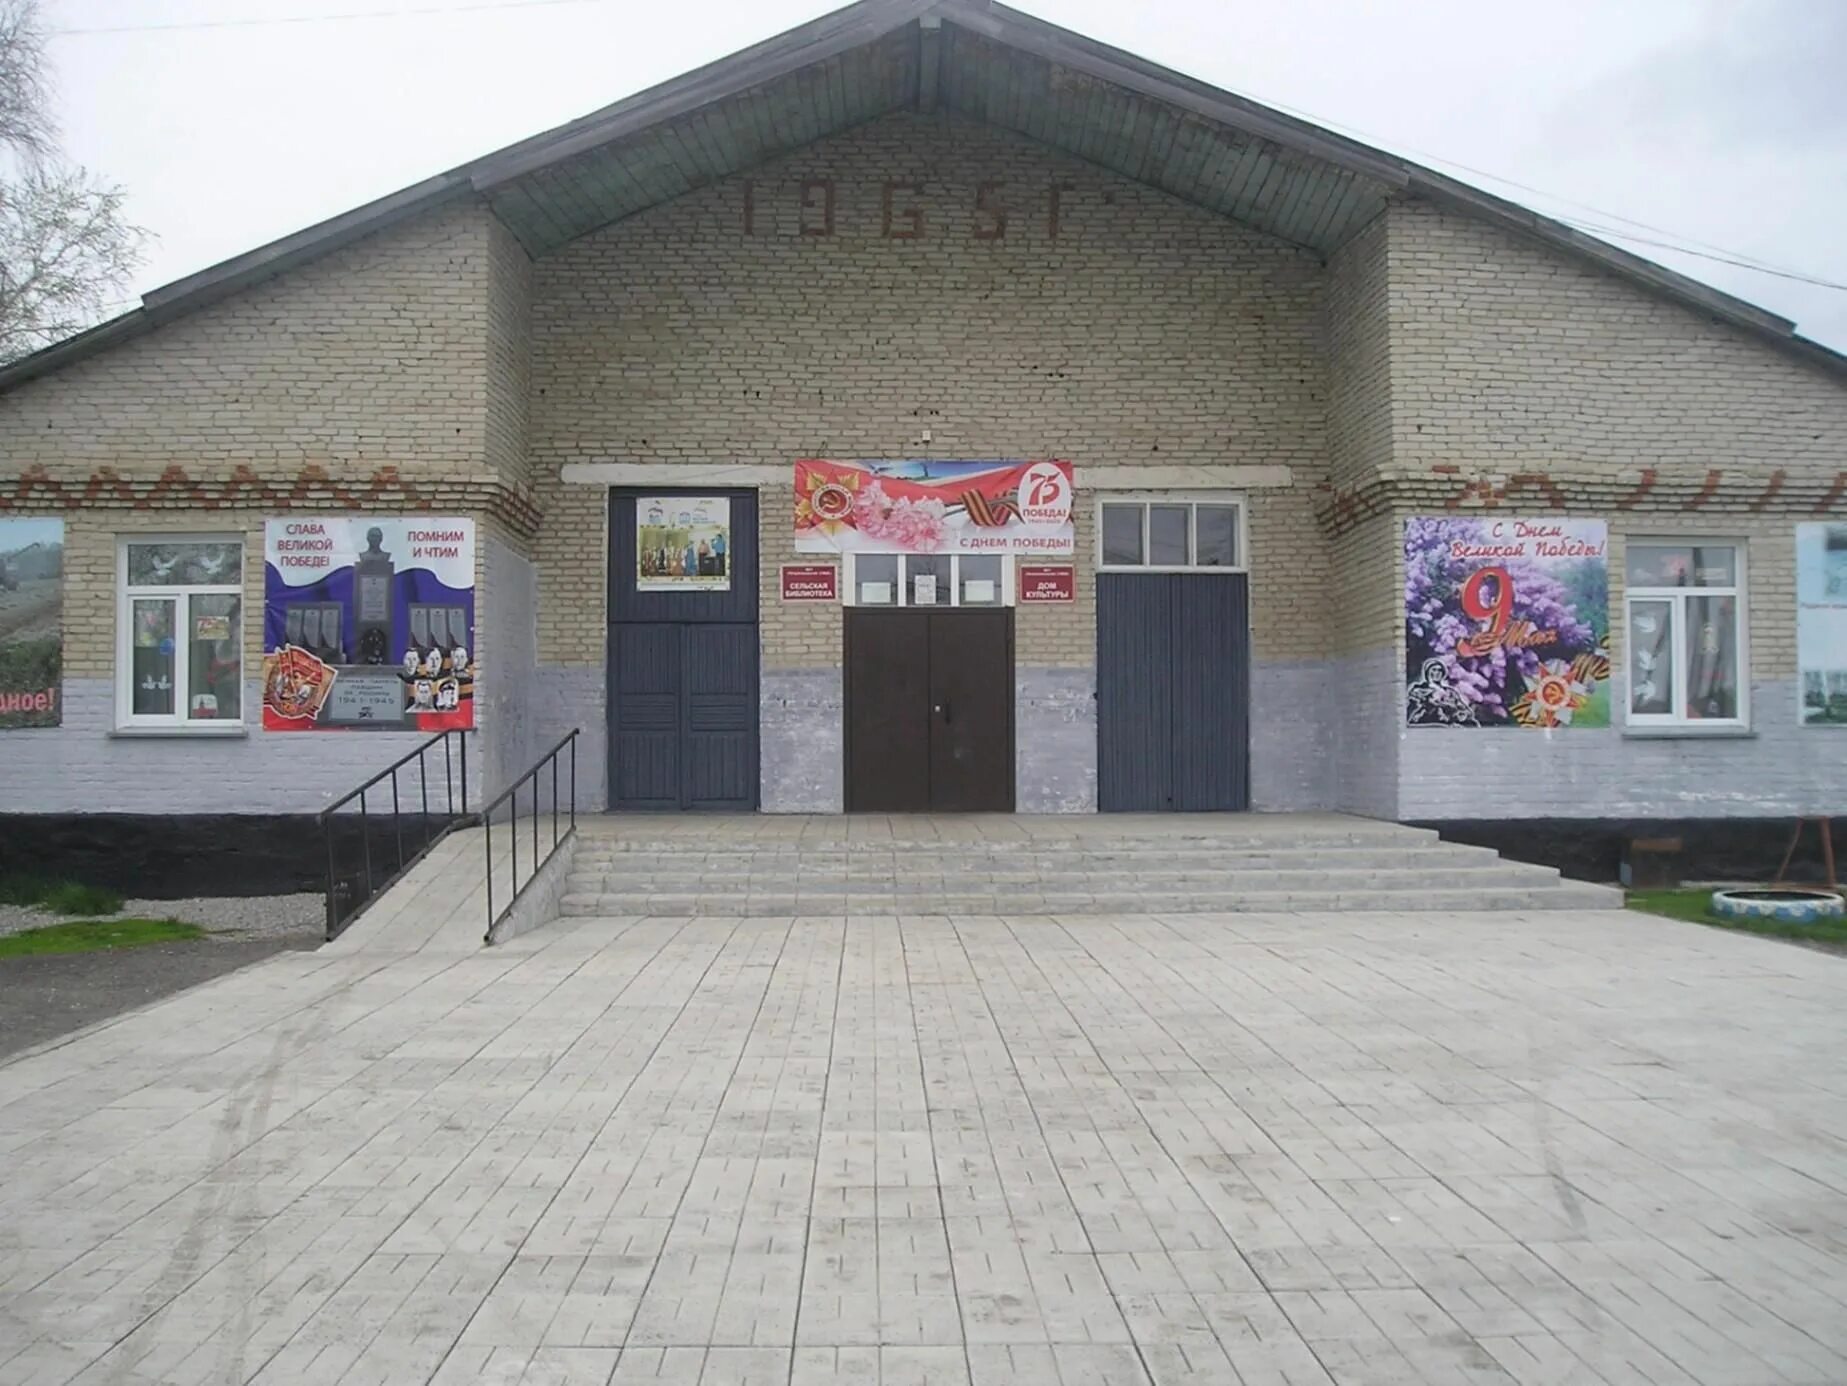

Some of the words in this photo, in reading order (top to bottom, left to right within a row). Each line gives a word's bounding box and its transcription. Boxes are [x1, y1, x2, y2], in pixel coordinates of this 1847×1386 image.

[1029, 471, 1061, 505] 75
[1023, 508, 1067, 519] ПОБЕДА!
[286, 523, 326, 536] СЛАВА
[1493, 522, 1502, 537] С
[407, 531, 465, 543] ПОМНИМ
[277, 537, 334, 551] ВЕЛИКОЙ
[959, 538, 969, 548] С
[970, 538, 1007, 549] ДНЕМ
[1012, 538, 1072, 549] ПОБЕДЫ!
[412, 547, 423, 558] И
[425, 547, 460, 559] ЧТИМ
[280, 556, 331, 568] ПОБЕДЕ!
[789, 582, 829, 590] СЕЛЬСКАЯ
[1037, 582, 1057, 590] ДОМ
[1026, 591, 1069, 599] КУЛЬТУРЫ
[1457, 567, 1514, 656] 9
